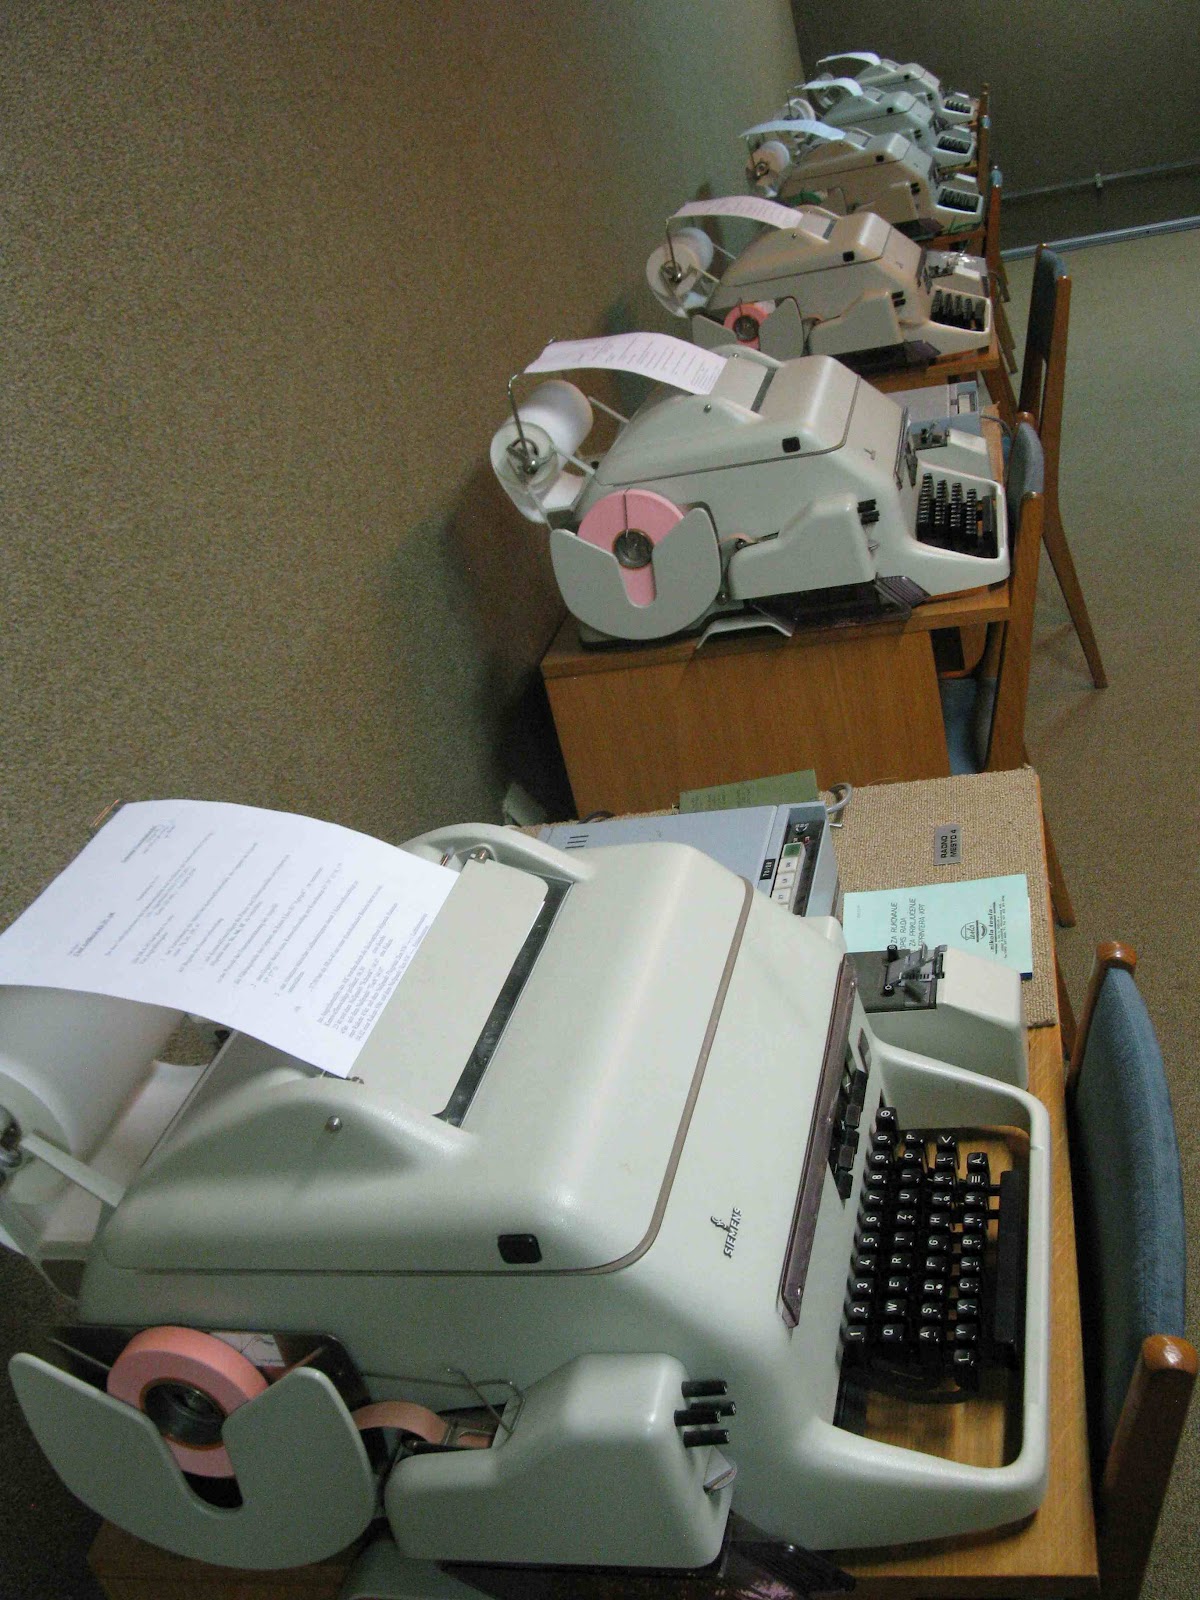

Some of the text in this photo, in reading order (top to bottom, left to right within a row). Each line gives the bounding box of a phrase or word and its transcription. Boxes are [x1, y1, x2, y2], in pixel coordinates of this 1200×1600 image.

[940, 836, 948, 858] RADNO
[890, 902, 898, 944] ZA RUKOVANJE
[723, 1206, 743, 1259] SIEMENS
[887, 1303, 897, 1312] W
